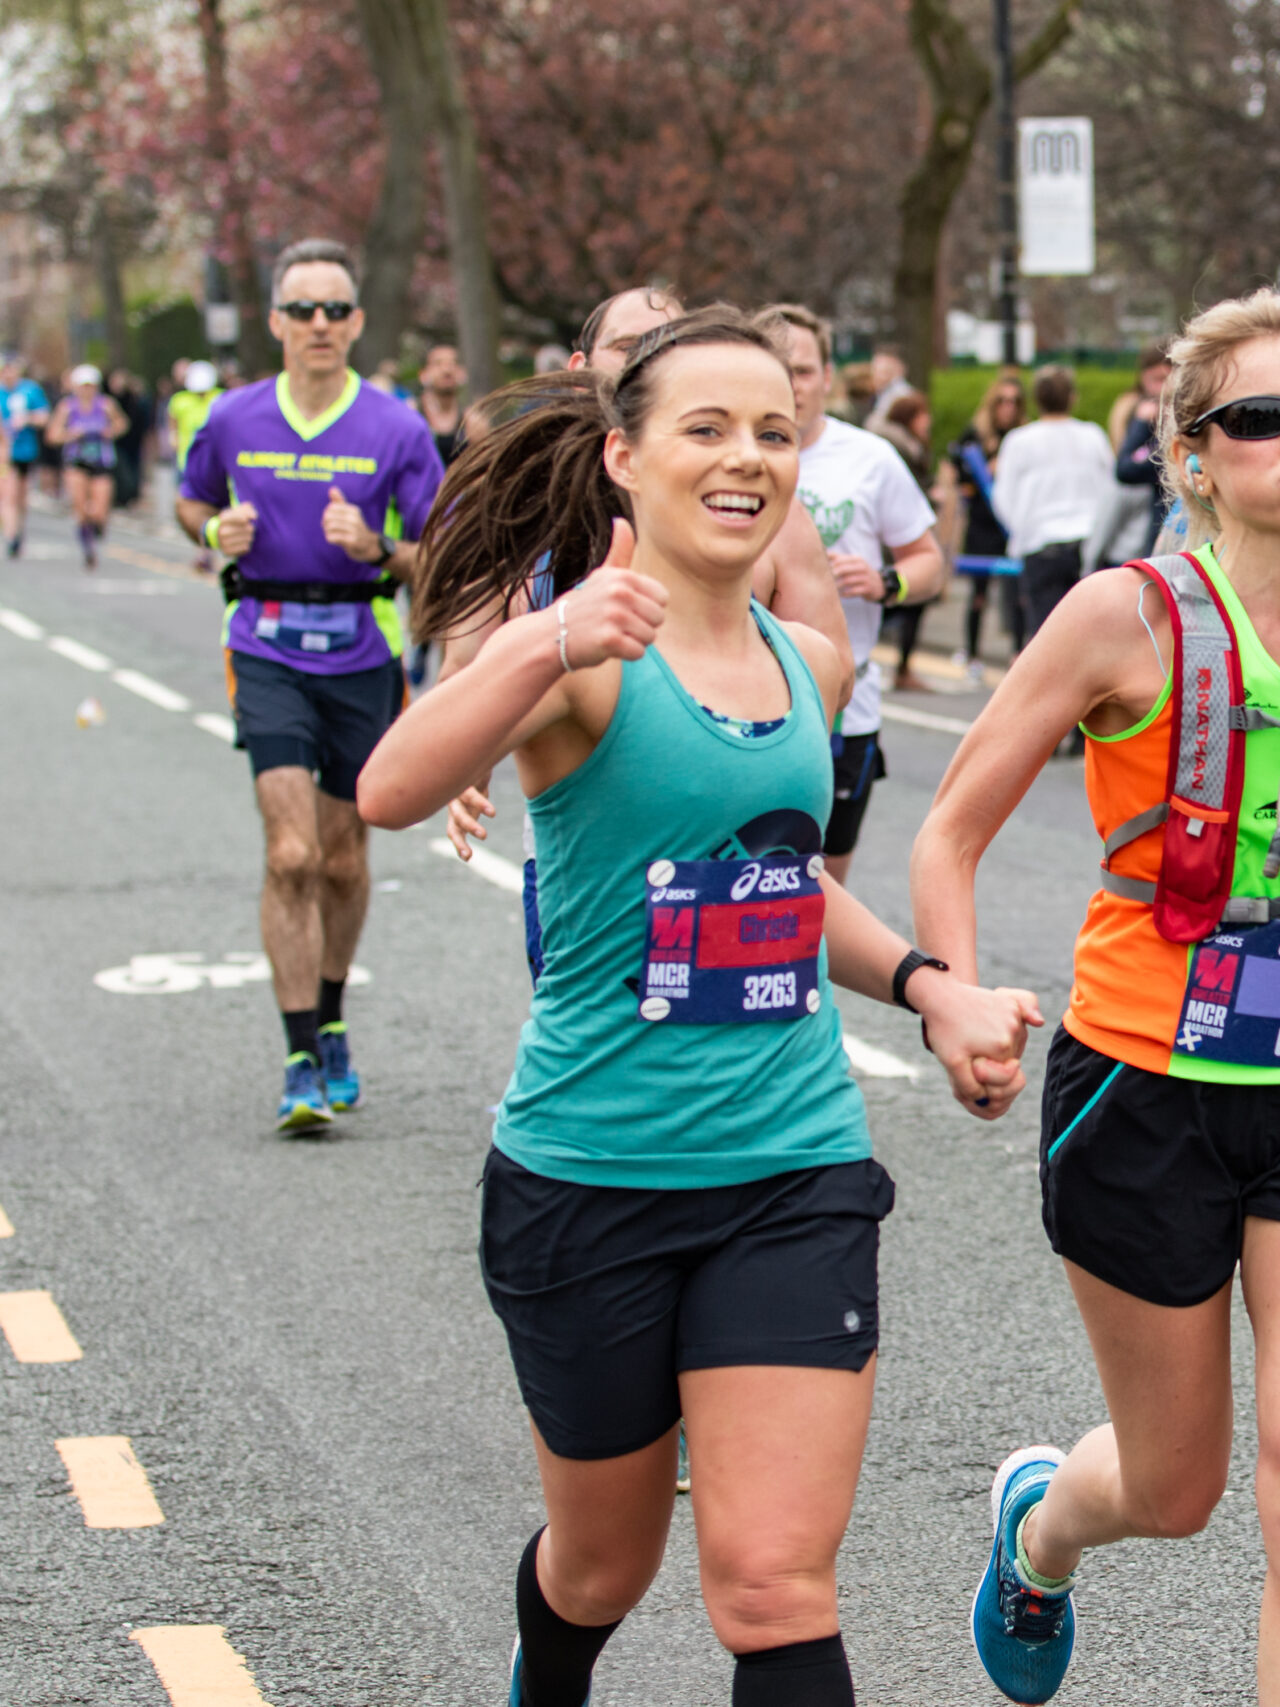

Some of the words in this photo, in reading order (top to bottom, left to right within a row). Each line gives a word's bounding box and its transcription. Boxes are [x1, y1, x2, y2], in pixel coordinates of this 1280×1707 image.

[1192, 693, 1211, 790] NATHAN
[758, 866, 800, 893] asics
[647, 963, 690, 987] MCR
[743, 971, 796, 1010] 3263
[1185, 999, 1228, 1028] MCR
